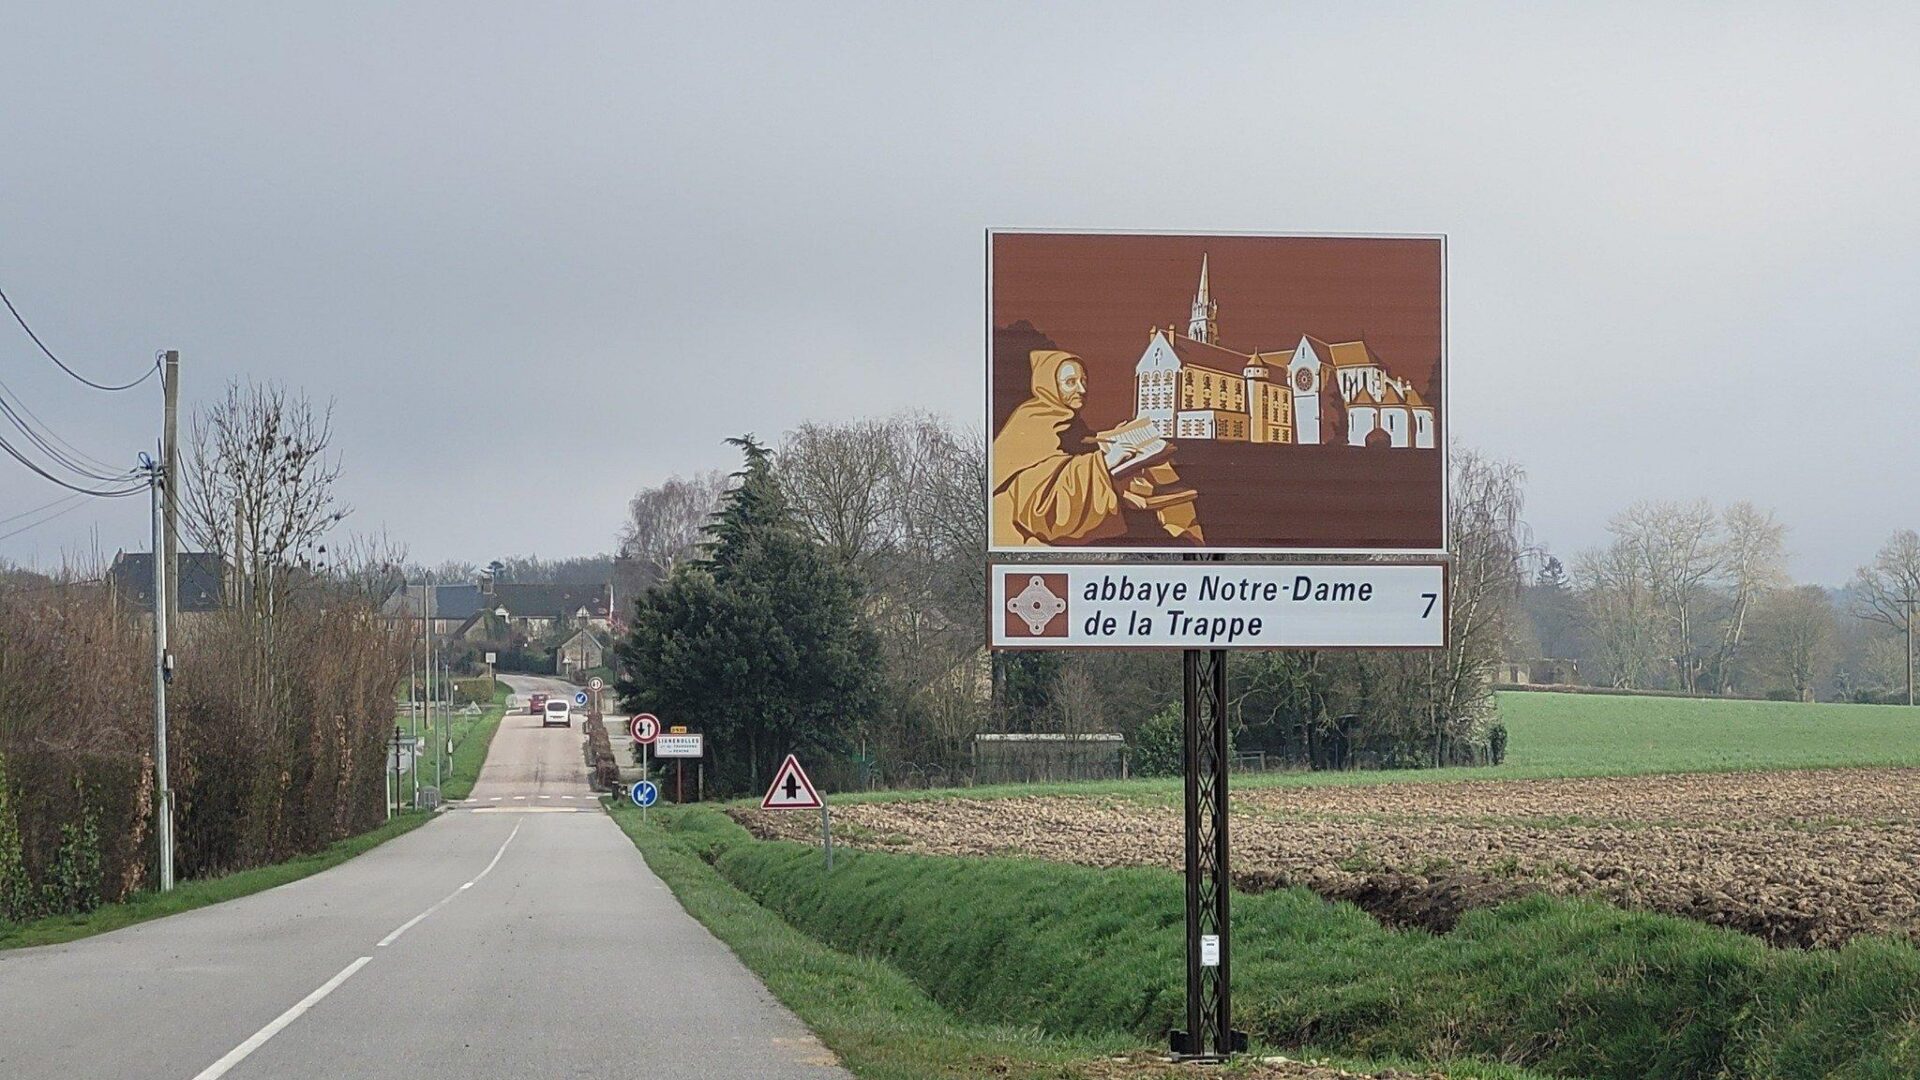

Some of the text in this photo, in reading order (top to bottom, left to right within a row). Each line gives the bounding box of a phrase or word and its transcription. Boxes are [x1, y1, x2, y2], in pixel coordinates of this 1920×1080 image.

[1083, 575, 1373, 607] abbaye Notre-Dame
[1421, 593, 1437, 619] 7
[1084, 610, 1263, 643] de la Trappe
